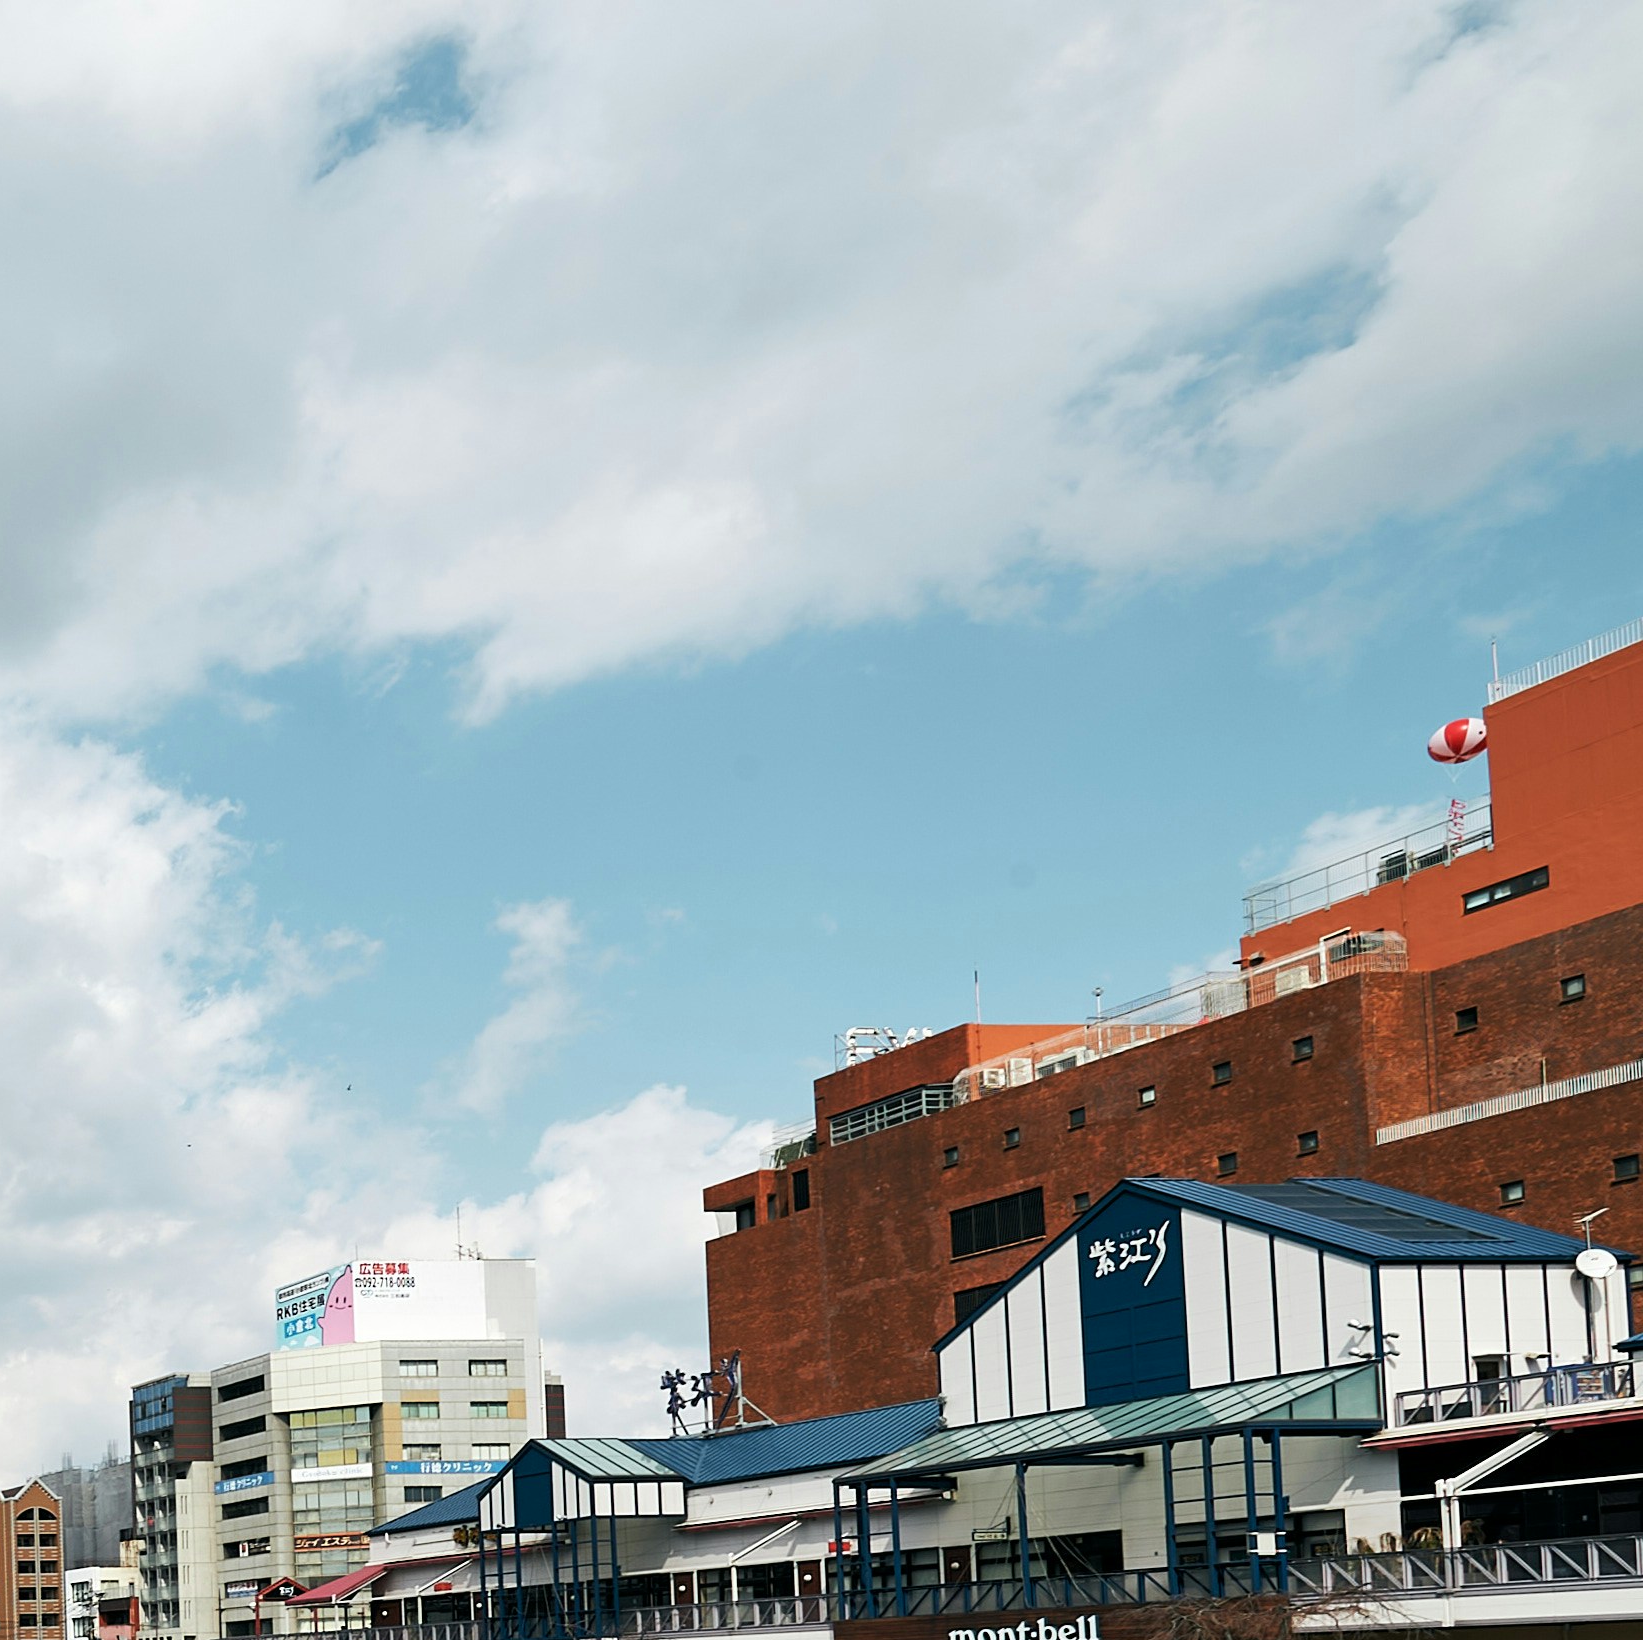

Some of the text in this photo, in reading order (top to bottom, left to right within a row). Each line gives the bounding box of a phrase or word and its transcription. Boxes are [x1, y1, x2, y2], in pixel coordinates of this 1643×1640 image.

[359, 1263, 410, 1275] 広告募集
[363, 1277, 416, 1288] 092-718-0088
